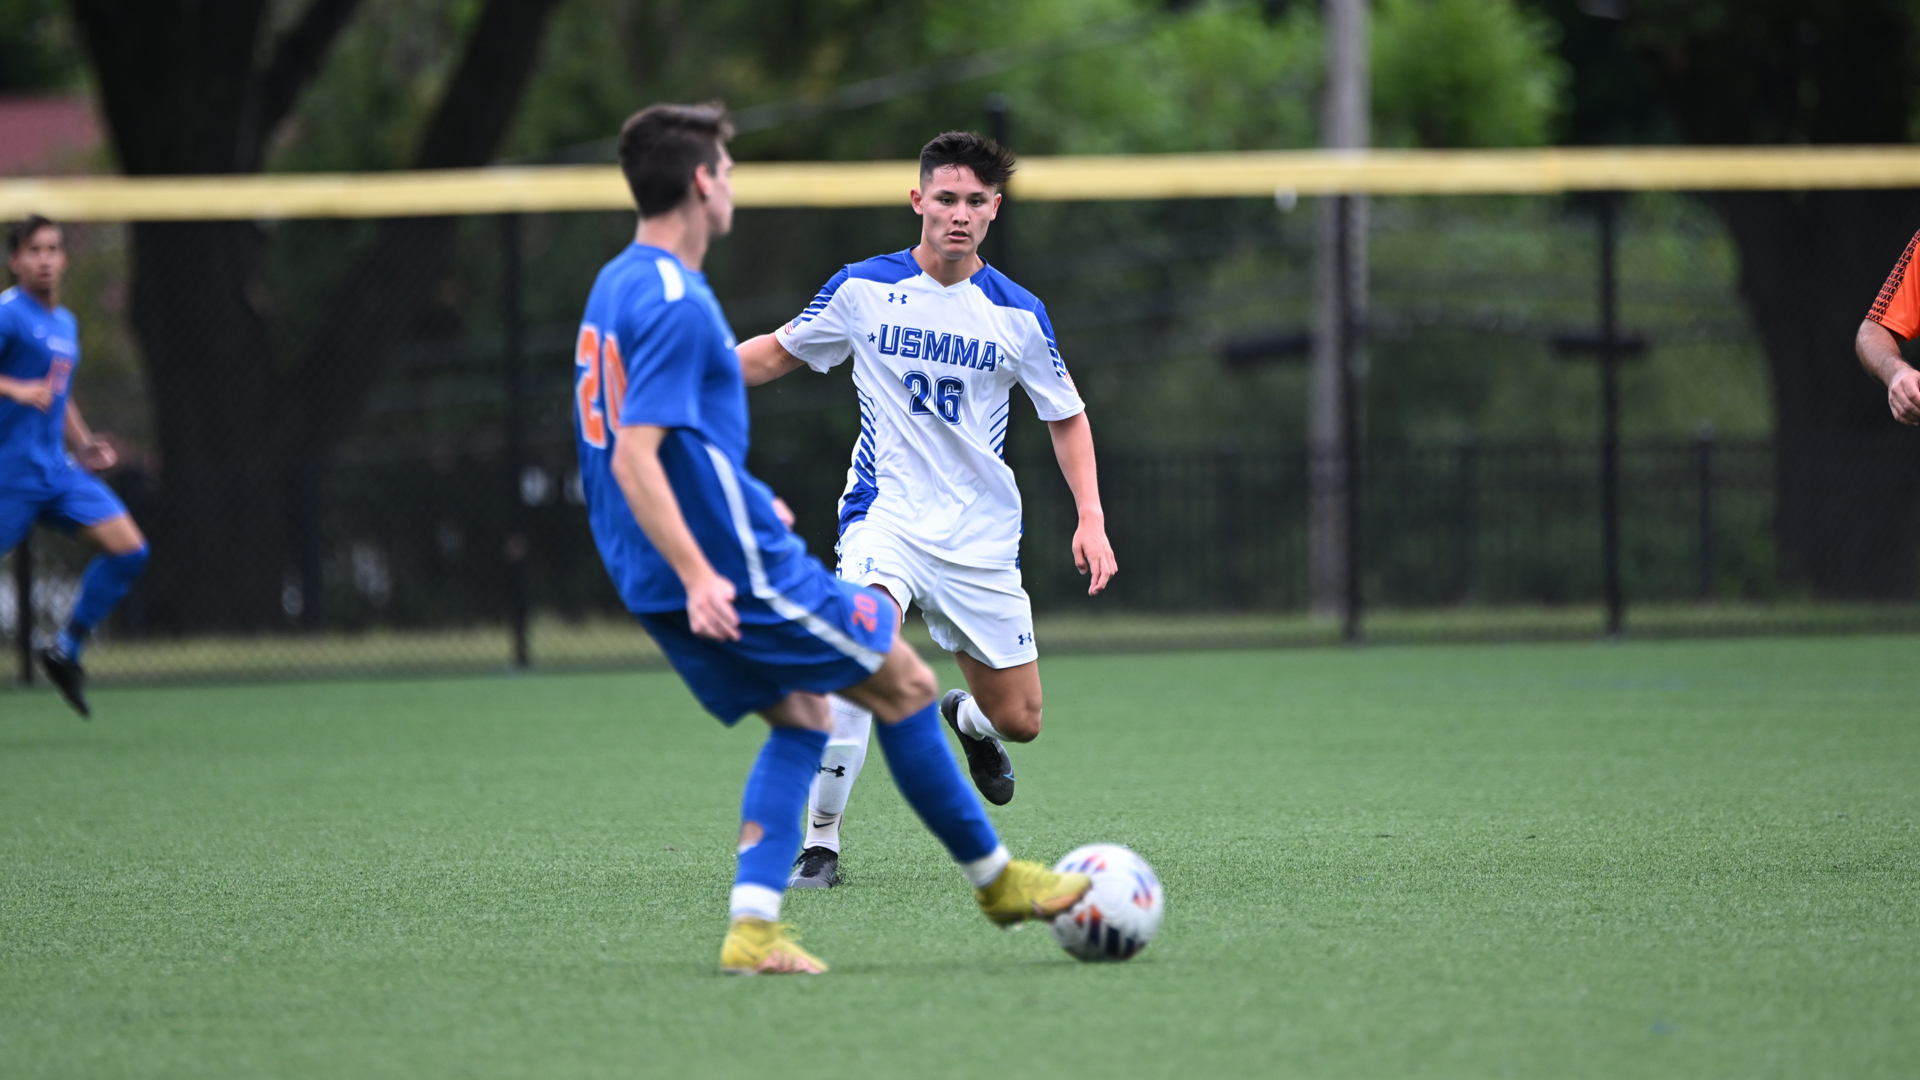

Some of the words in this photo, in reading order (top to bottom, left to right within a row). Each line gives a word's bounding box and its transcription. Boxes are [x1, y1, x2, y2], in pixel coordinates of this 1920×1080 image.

[878, 324, 997, 372] USMMA
[575, 325, 628, 449] 20
[901, 370, 965, 425] 26
[851, 593, 878, 633] 20
